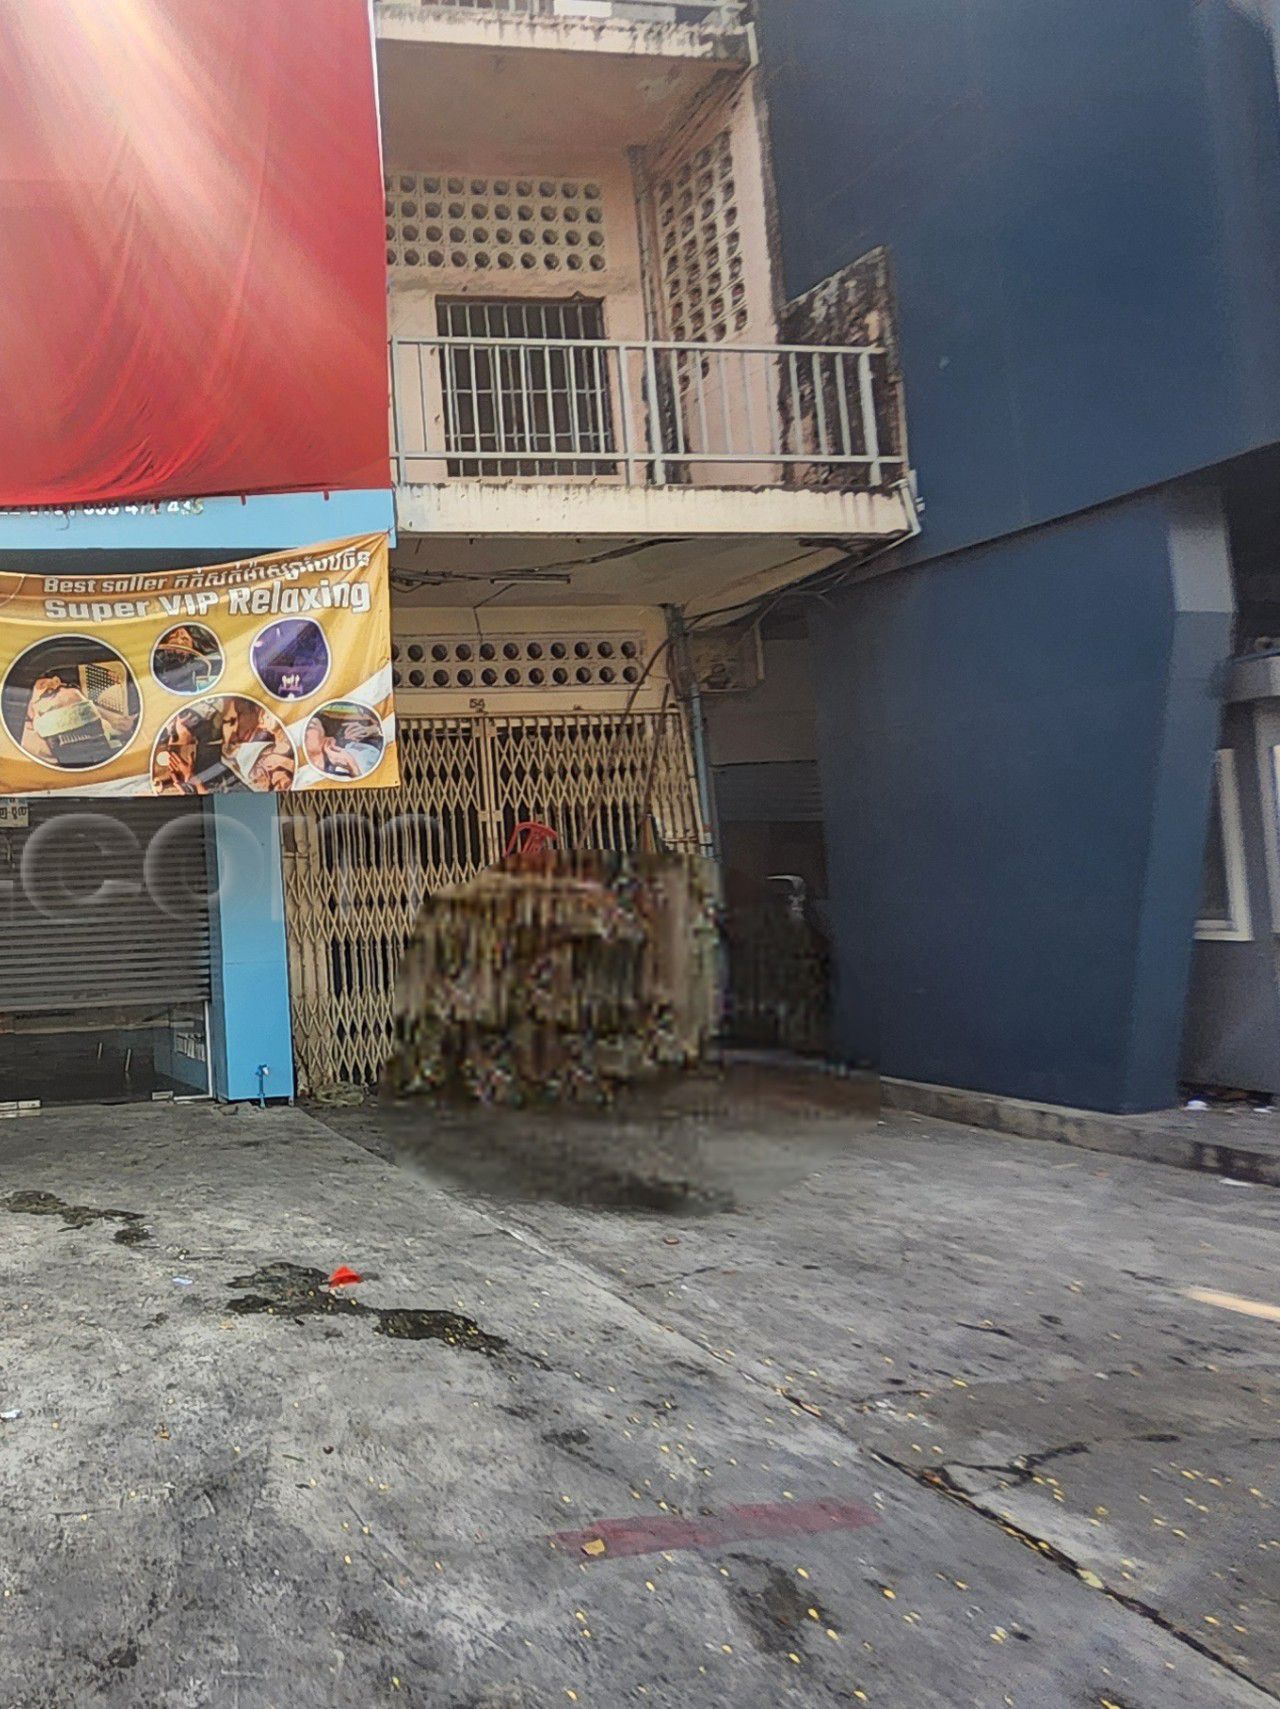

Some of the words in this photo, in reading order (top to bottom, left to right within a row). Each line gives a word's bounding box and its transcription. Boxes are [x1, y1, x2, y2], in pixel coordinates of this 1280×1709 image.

[43, 576, 96, 593] Best
[44, 599, 150, 623] Super
[158, 591, 220, 616] VIP
[228, 579, 371, 615] Relaxing
